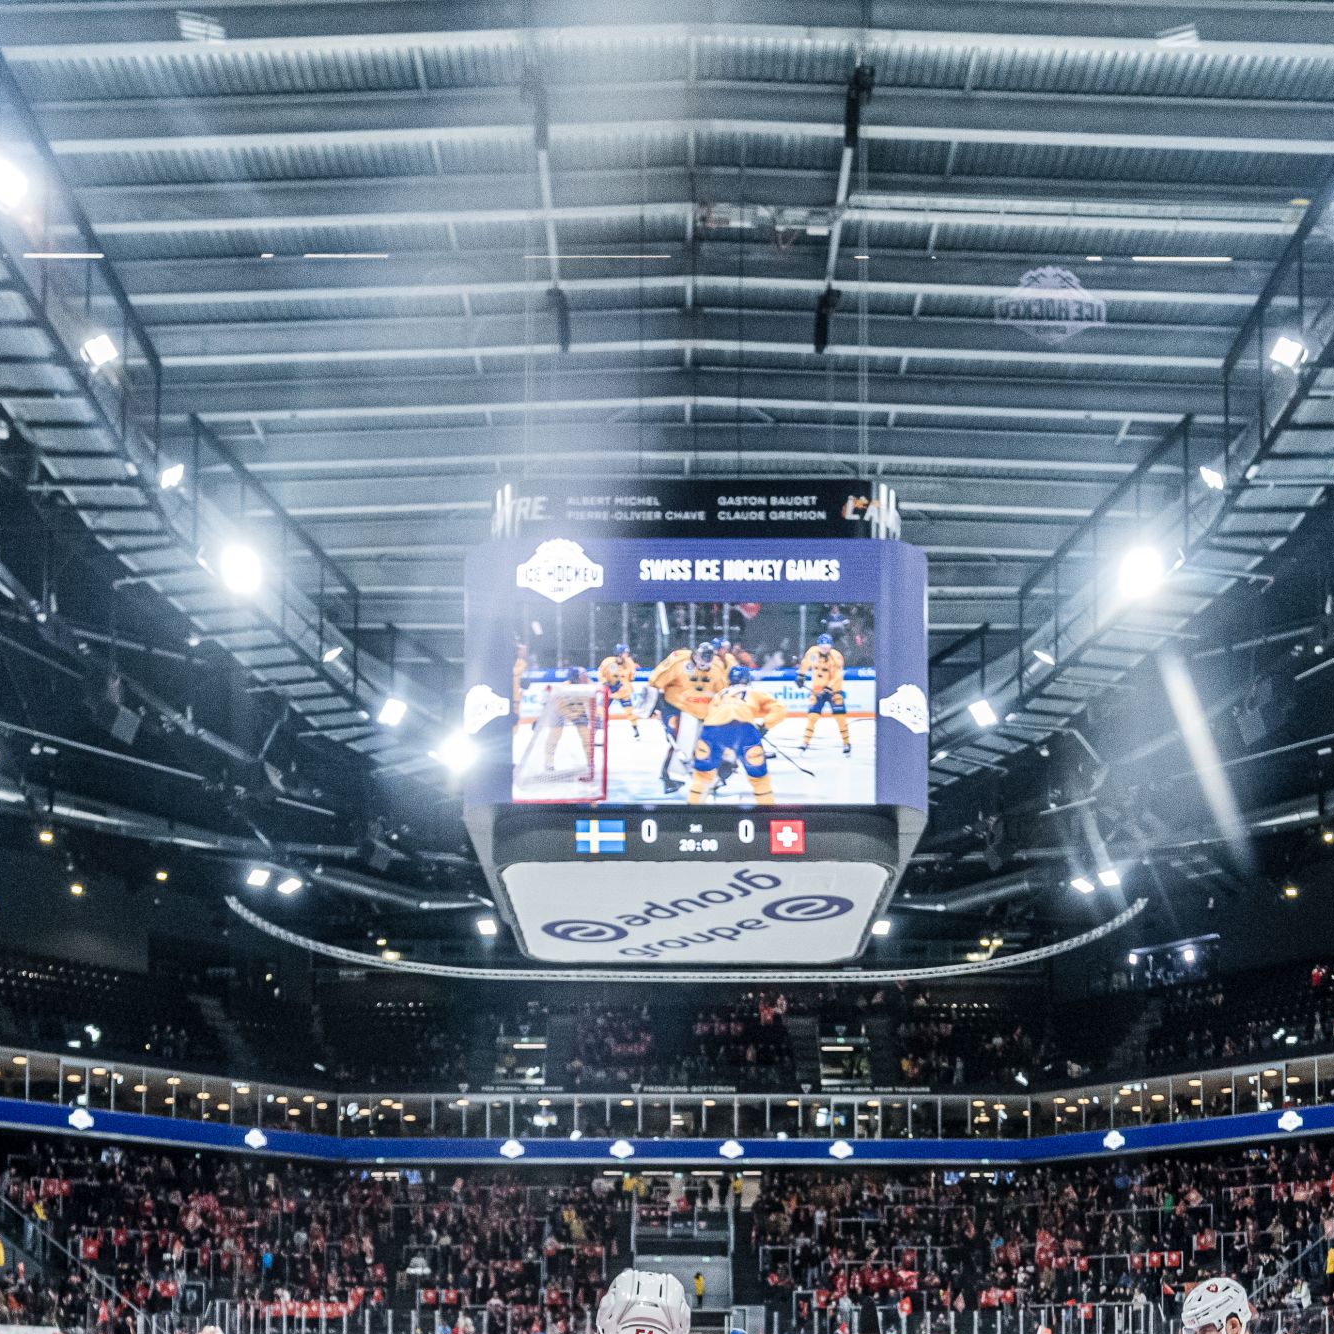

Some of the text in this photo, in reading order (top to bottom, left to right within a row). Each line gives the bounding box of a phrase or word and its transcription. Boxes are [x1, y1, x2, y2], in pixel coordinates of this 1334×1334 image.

[614, 496, 661, 506] MICHEL
[717, 495, 818, 506] GASTON BAUDET
[665, 510, 706, 521] CHAVE
[717, 510, 827, 521] CLAUDE GREMION
[639, 558, 841, 581] SWISS ICE HOCKEY GAMES
[641, 818, 658, 843] 0
[738, 818, 755, 843] 0
[678, 838, 719, 852] 20:00
[617, 869, 783, 930] groupe
[619, 917, 772, 957] groupe
